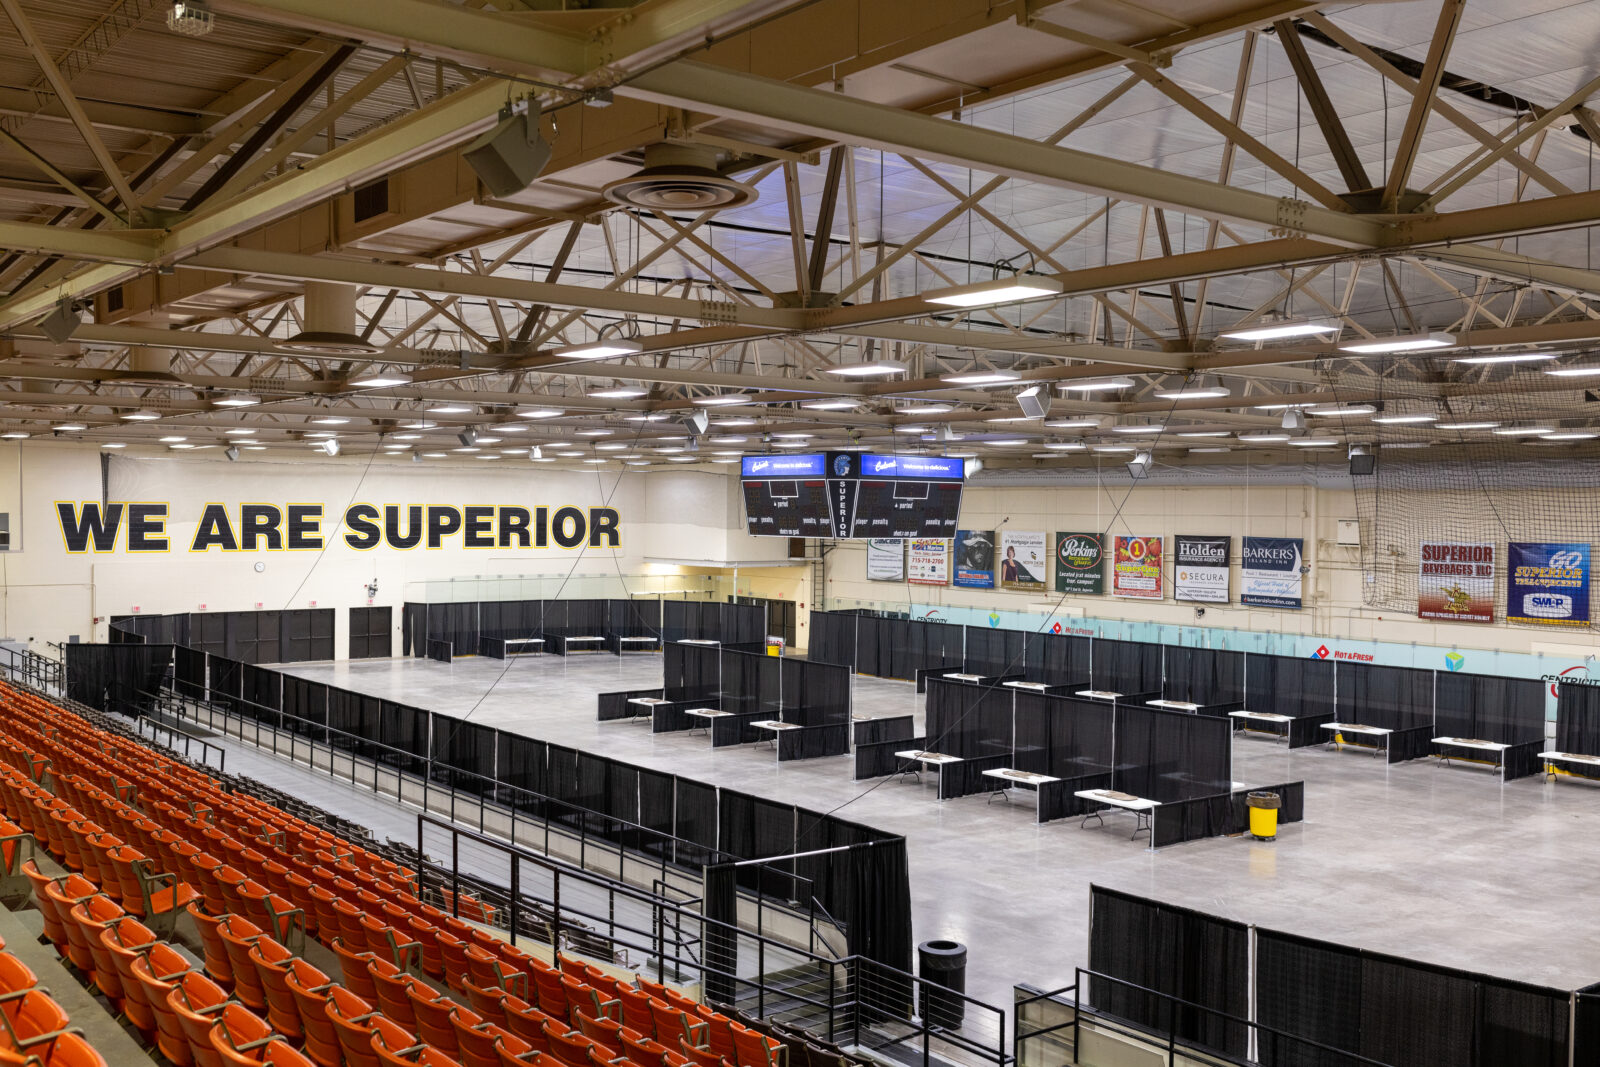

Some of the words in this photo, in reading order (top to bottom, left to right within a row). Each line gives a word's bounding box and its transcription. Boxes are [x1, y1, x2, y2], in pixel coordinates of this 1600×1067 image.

[839, 481, 847, 536] SUPERIOR
[55, 502, 170, 552] WE
[189, 502, 325, 552] ARE
[342, 503, 622, 551] SUPERIOR
[872, 518, 888, 526] penalty
[1134, 543, 1140, 556] 1
[1179, 543, 1225, 556] Holden
[1243, 547, 1294, 560] BARKERS
[1422, 544, 1493, 562] SUPERIOR
[912, 557, 944, 565] 715-718-2700
[1549, 550, 1582, 569] GO
[1115, 563, 1160, 573] SuperOne
[1423, 563, 1473, 575] BEVERAGES
[1476, 565, 1492, 576] LLC
[1515, 566, 1583, 578] SUPERIOR
[1189, 572, 1225, 582] SECURA
[1515, 577, 1583, 588] YELLOWJACKETS
[1334, 650, 1374, 662] HOT&FRESH
